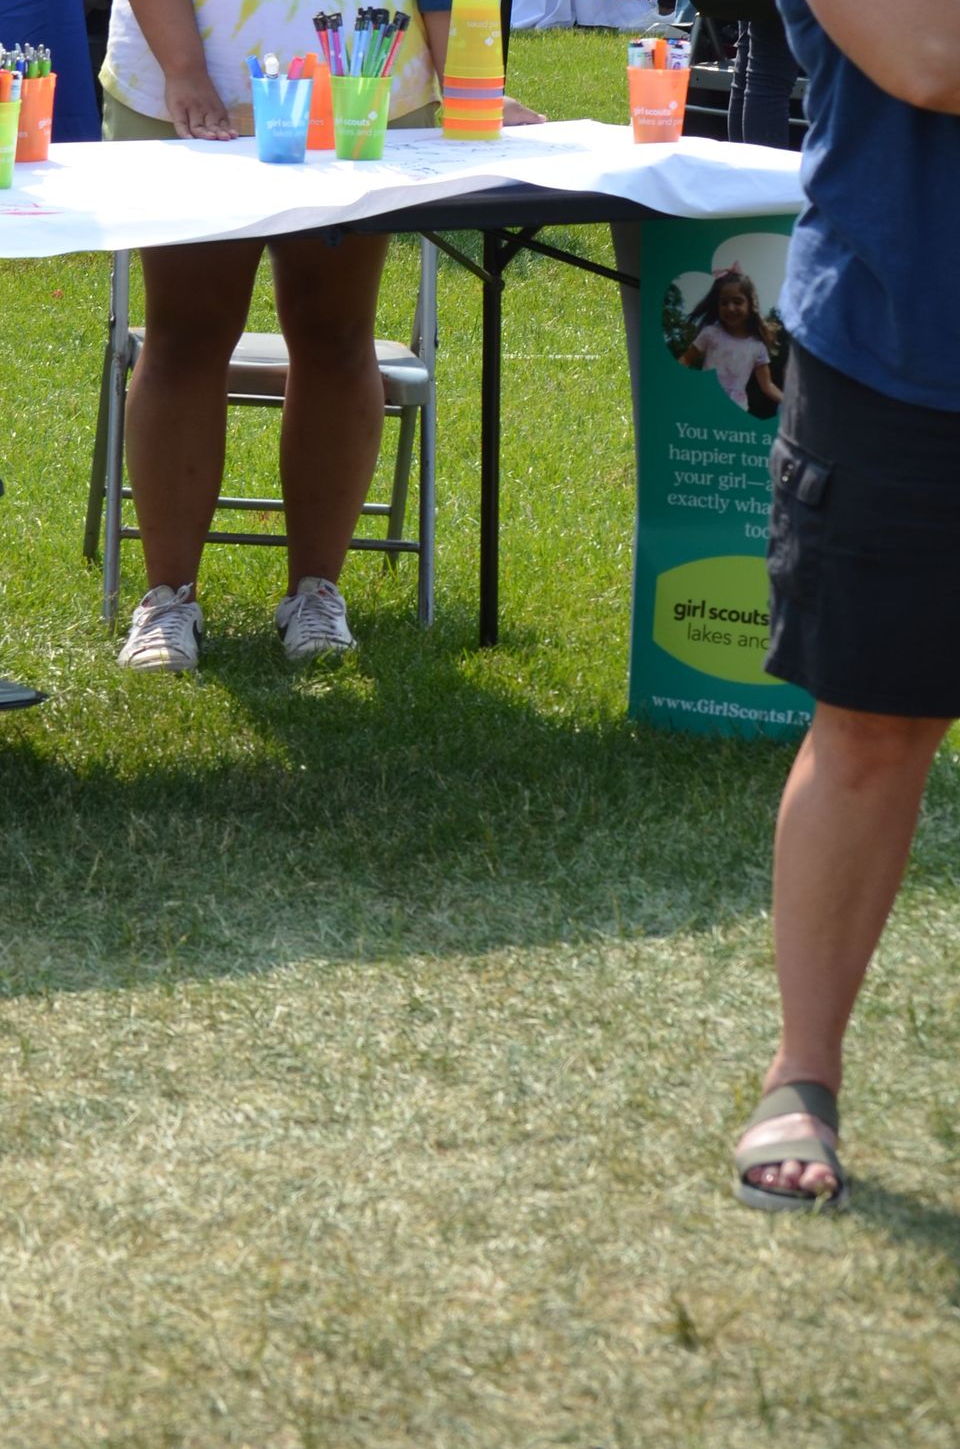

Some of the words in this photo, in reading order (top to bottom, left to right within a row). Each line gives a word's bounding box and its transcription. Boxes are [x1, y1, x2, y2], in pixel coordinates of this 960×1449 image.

[676, 422, 708, 440] You
[712, 429, 758, 445] want
[762, 433, 772, 446] a
[668, 444, 736, 467] happier
[674, 471, 714, 487] your
[667, 492, 730, 514] exactly
[735, 497, 771, 515] wha
[673, 600, 706, 621] girl
[709, 606, 770, 626] scouts
[687, 622, 732, 646] lakes
